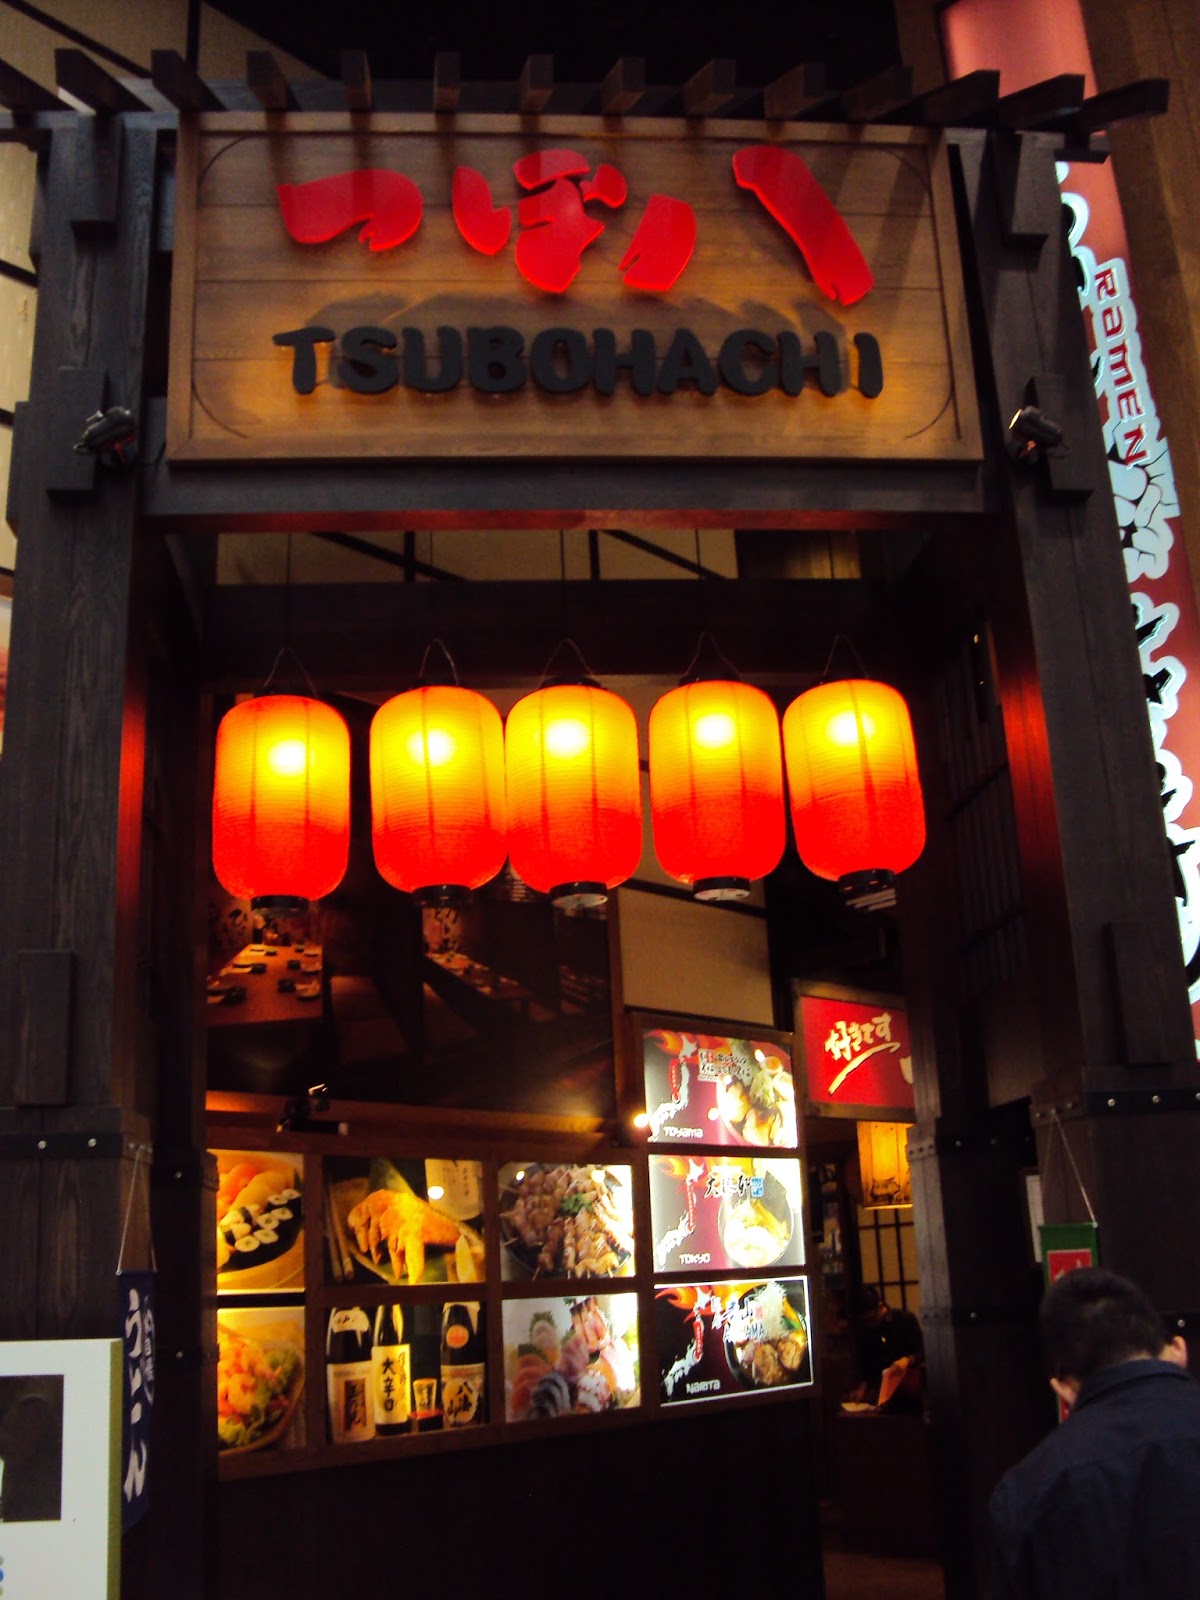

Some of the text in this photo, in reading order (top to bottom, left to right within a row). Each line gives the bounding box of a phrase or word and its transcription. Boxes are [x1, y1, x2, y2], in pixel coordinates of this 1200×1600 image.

[277, 148, 875, 307] つぼ八
[272, 325, 884, 399] TSUBOHACHI
[382, 1356, 397, 1412] 大辛口
